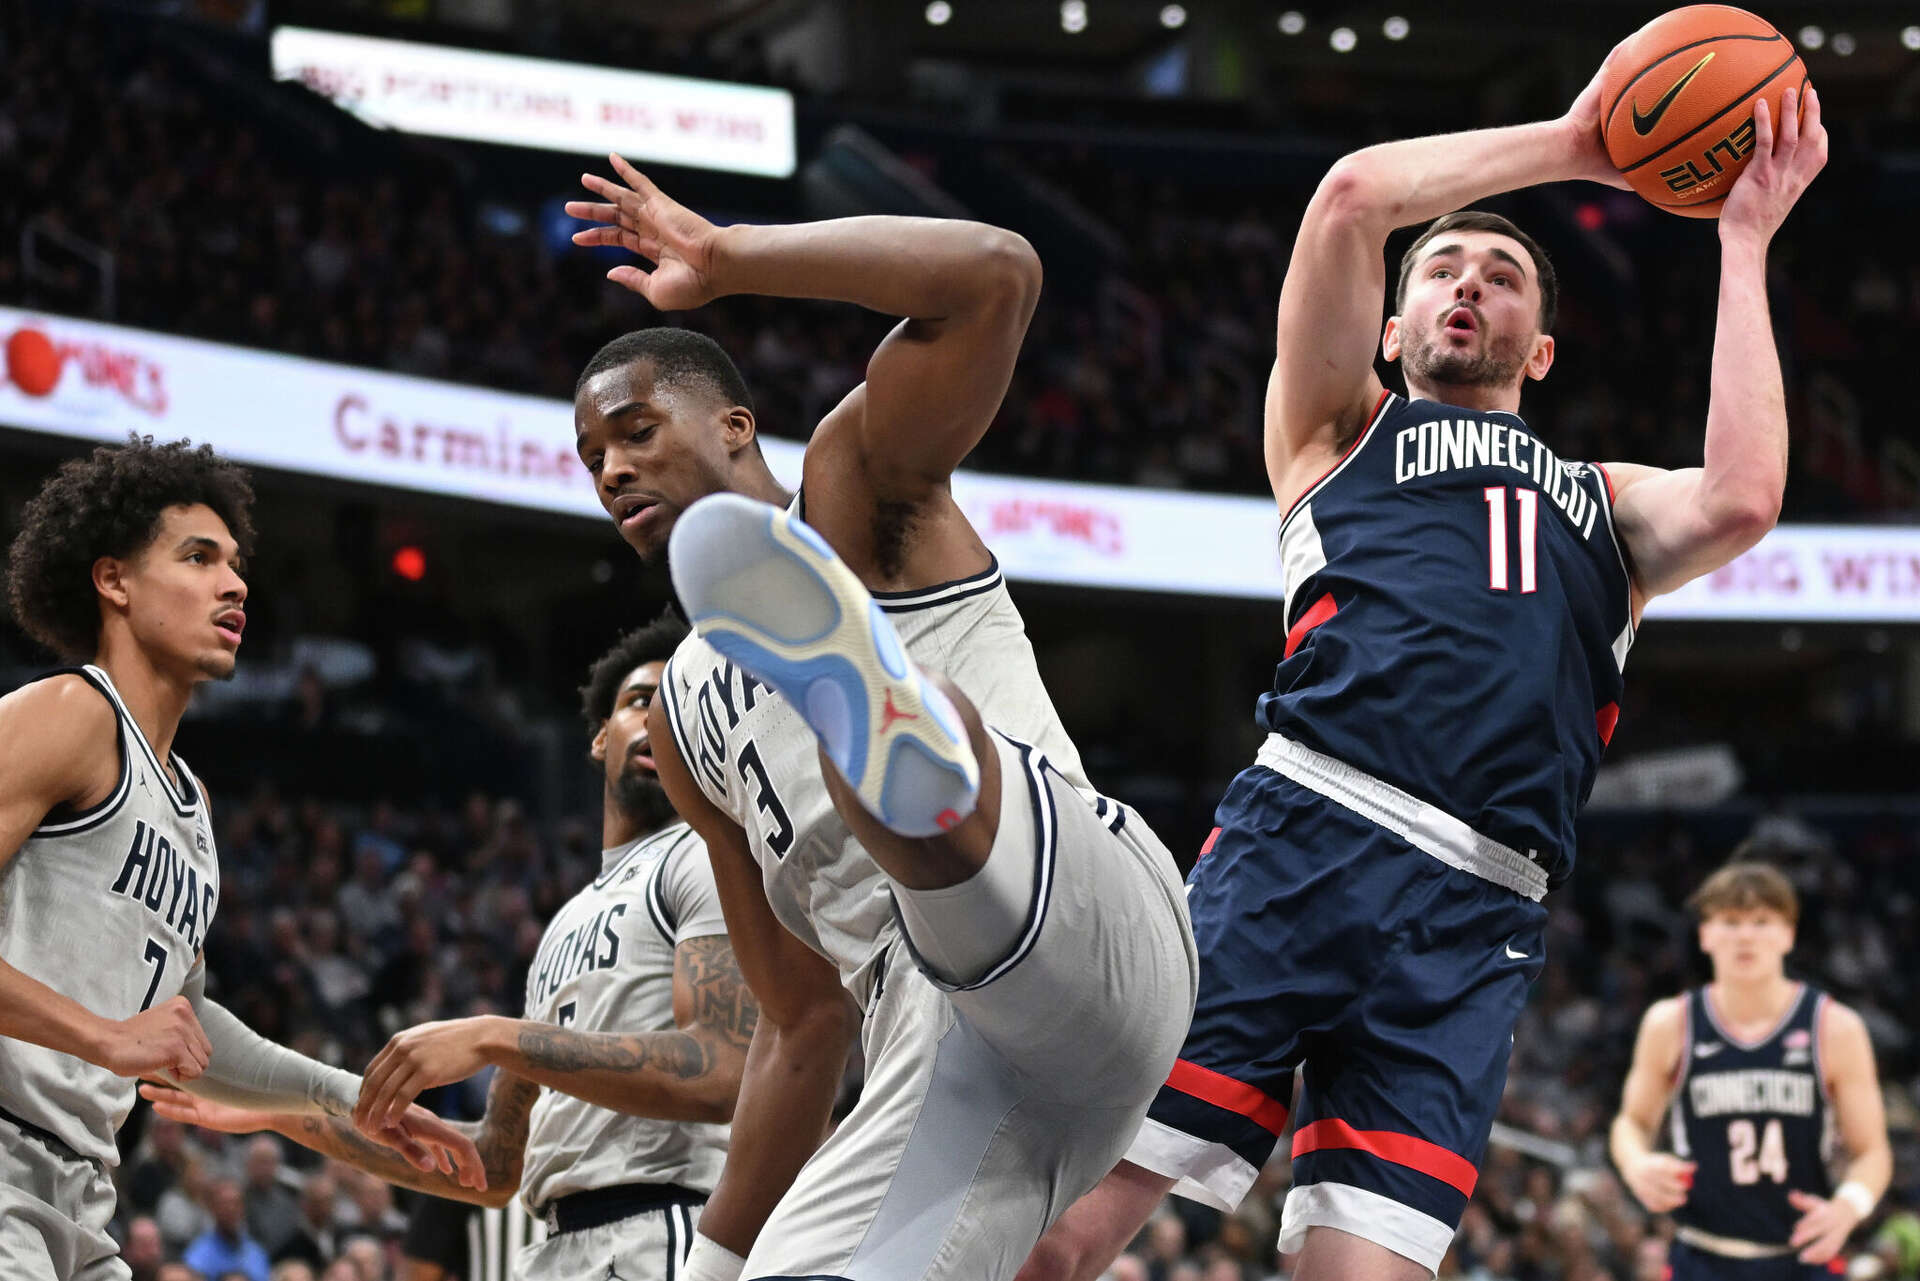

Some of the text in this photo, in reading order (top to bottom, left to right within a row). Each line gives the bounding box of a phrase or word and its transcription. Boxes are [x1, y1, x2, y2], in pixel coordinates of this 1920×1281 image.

[1396, 419, 1598, 541] CONNECTICUT
[1484, 486, 1538, 594] 11
[737, 736, 795, 862] 3
[139, 935, 169, 1015] 7
[536, 902, 628, 1005] HOYAS
[1727, 1119, 1788, 1185] 24
